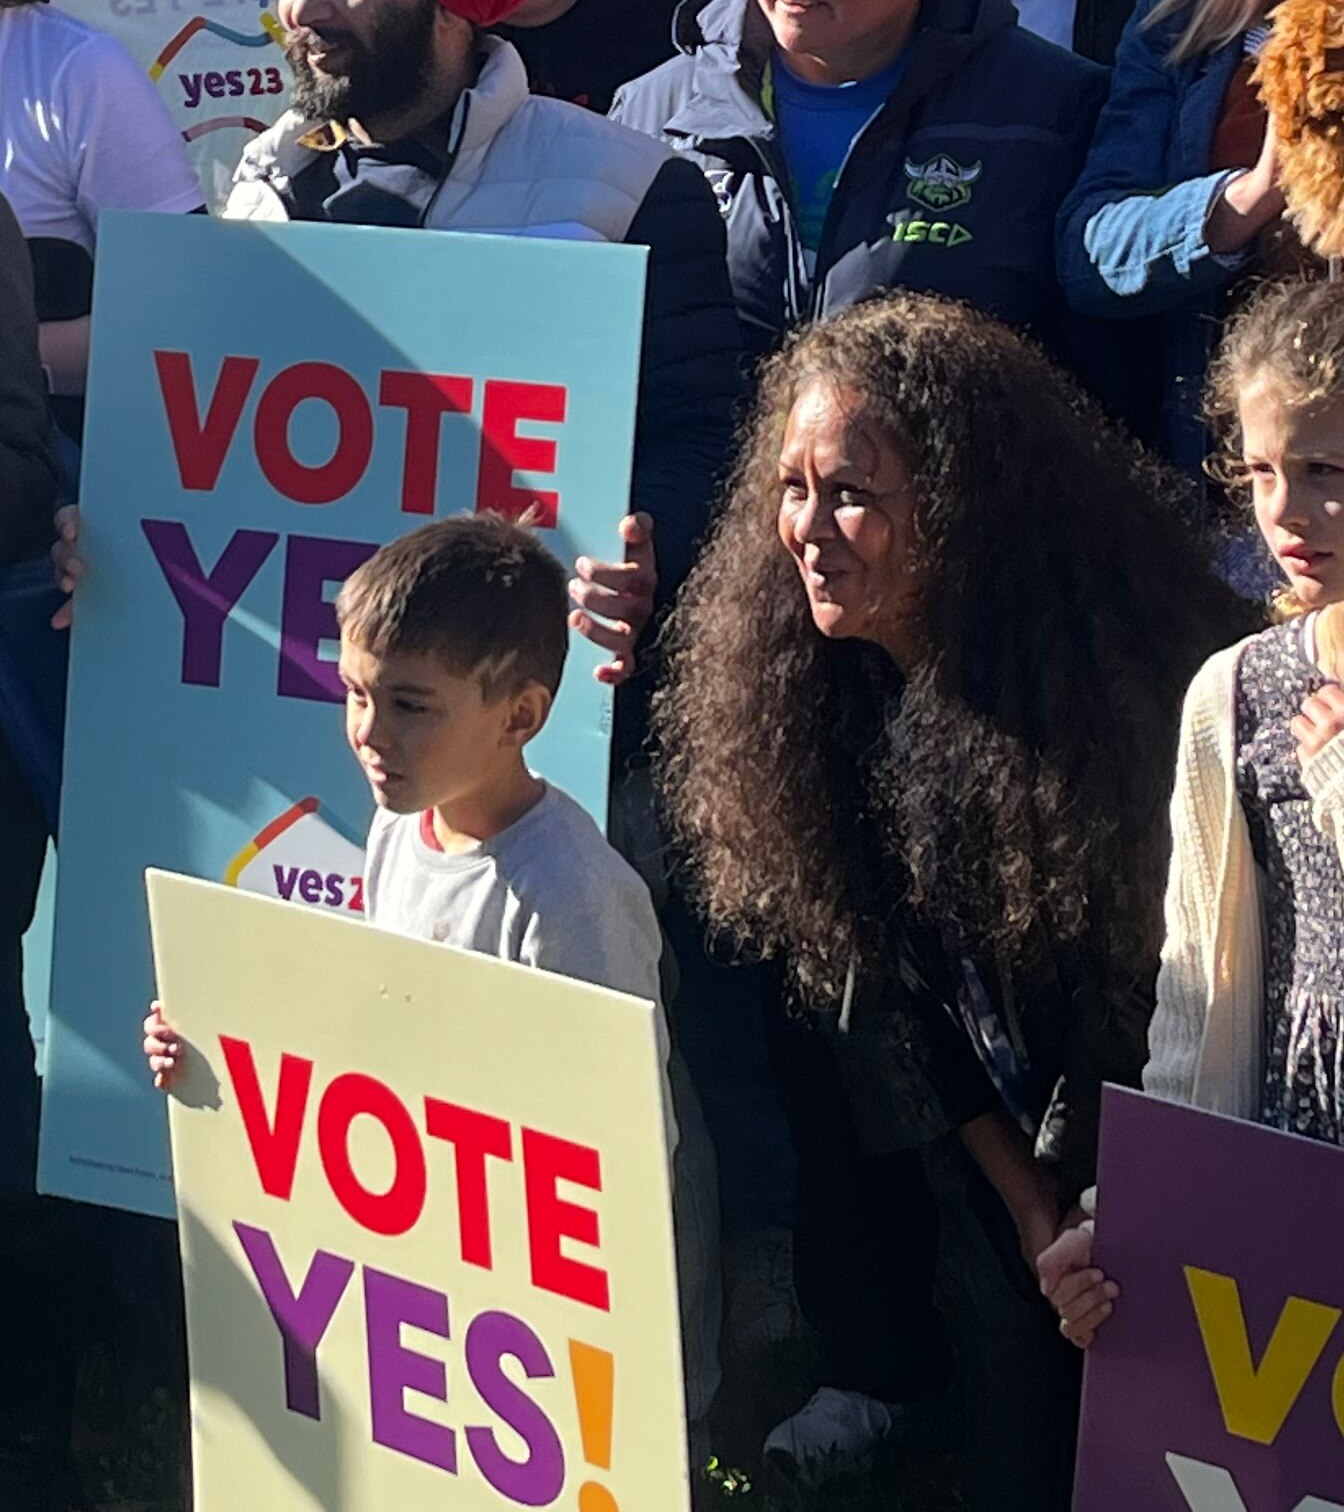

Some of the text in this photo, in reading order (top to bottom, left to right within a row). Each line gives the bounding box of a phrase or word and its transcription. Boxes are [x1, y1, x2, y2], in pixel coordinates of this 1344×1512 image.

[179, 67, 284, 108] yes23
[153, 350, 566, 530] VOTE
[141, 518, 379, 704] YE
[273, 864, 365, 912] yes2
[218, 1034, 610, 1313] VOTE
[232, 1220, 619, 1512] YES!
